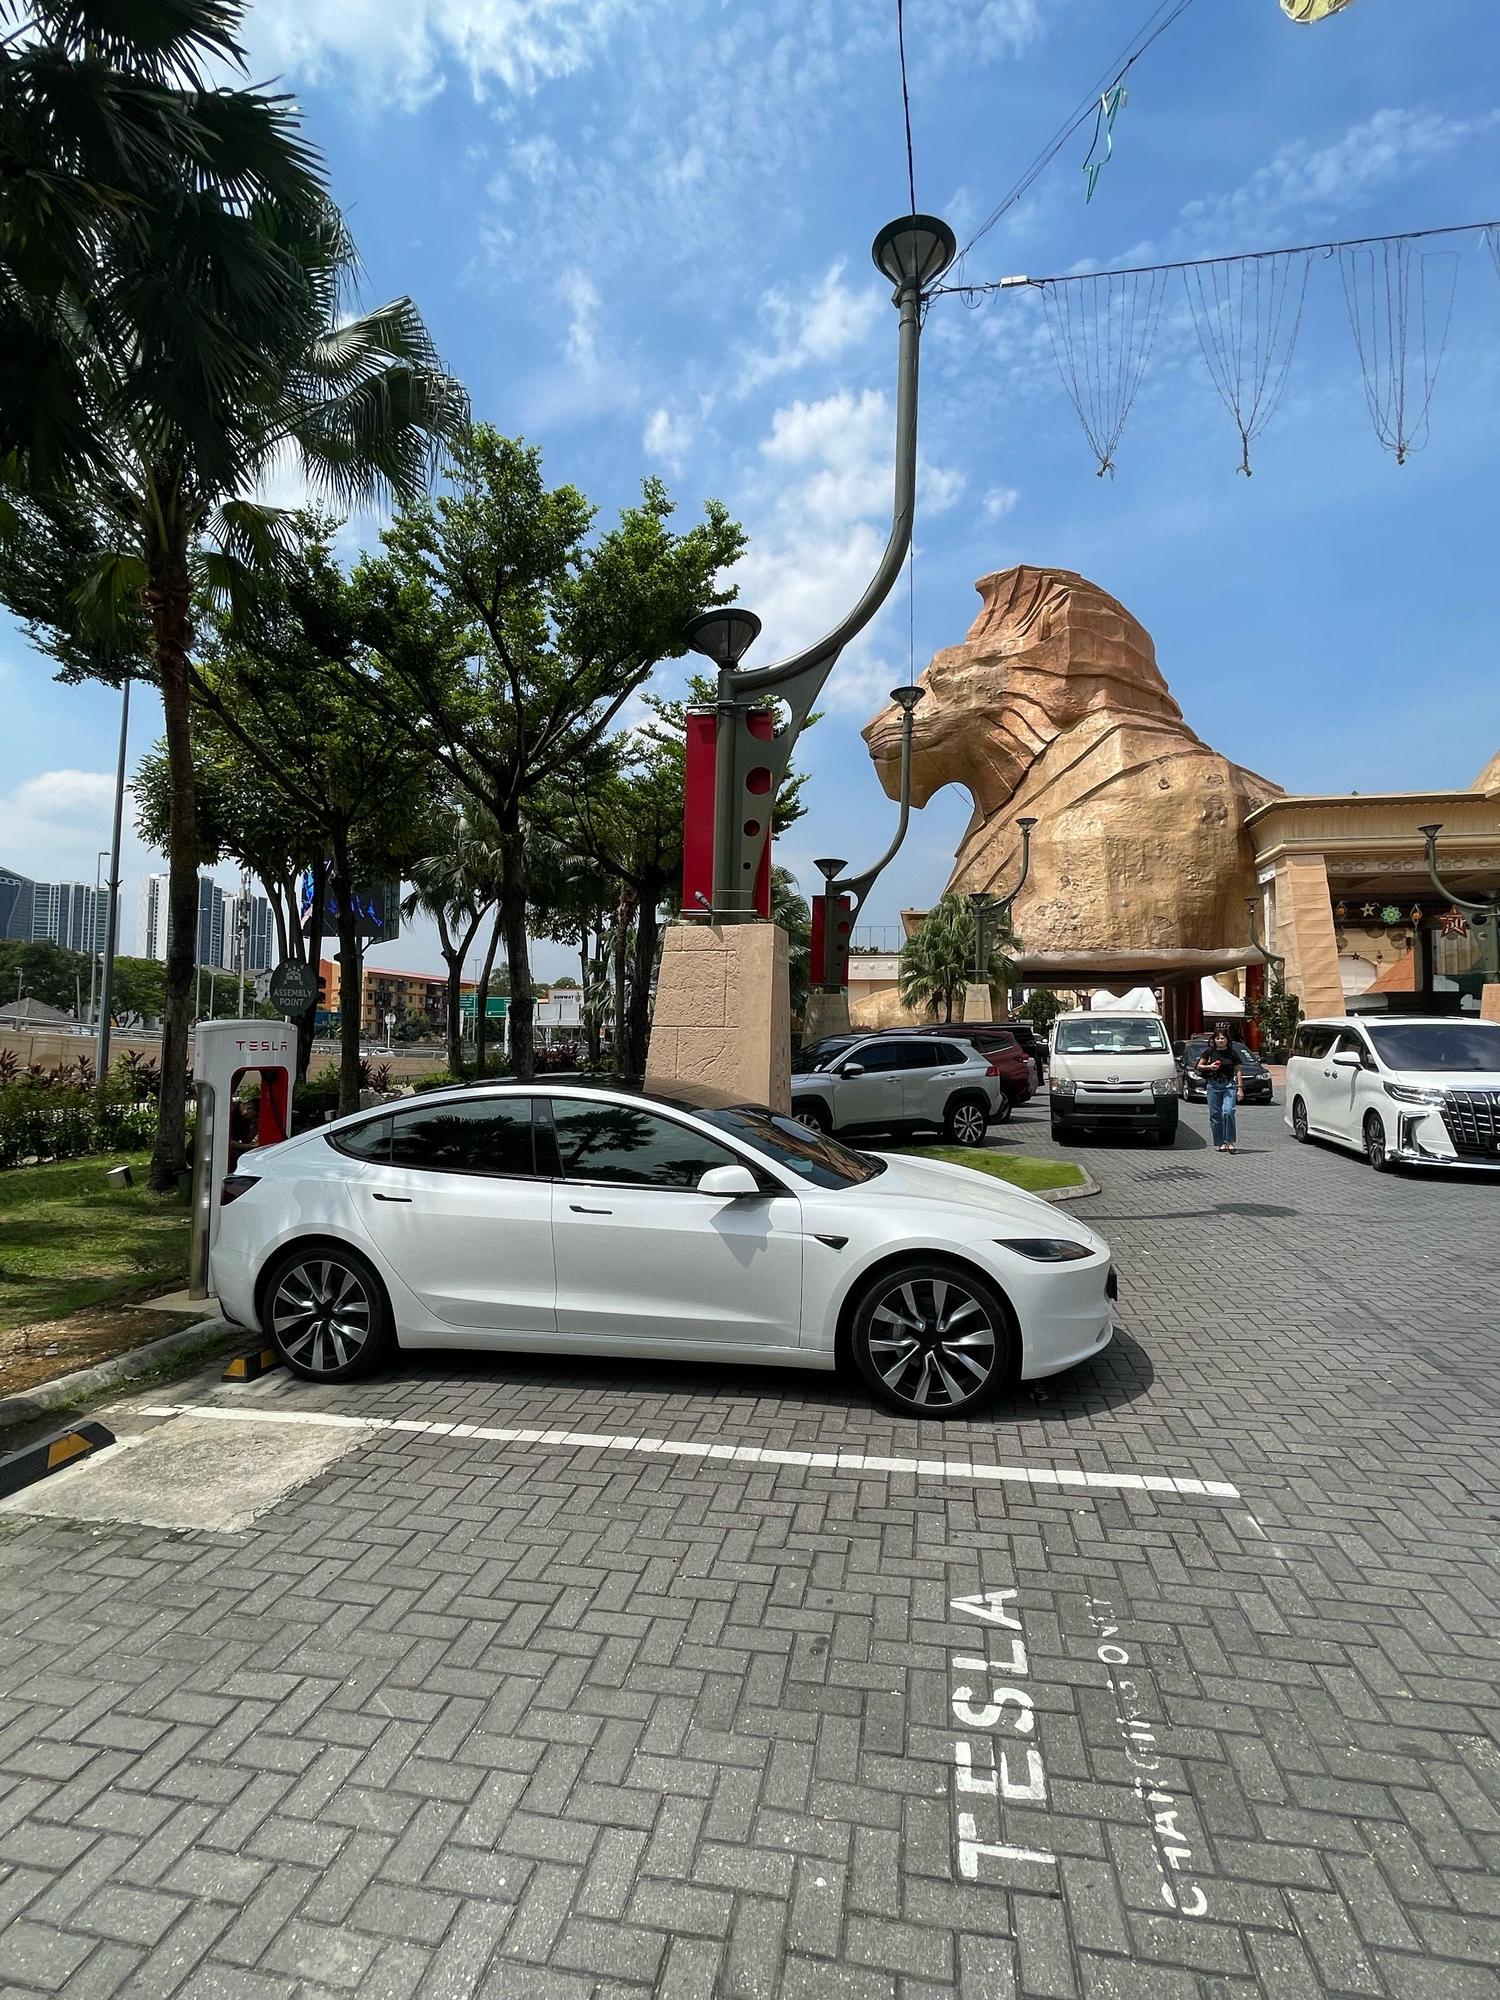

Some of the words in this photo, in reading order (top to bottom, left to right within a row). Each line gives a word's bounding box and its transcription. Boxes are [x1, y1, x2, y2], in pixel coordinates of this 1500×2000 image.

[273, 988, 313, 998] ASSEMBLY
[279, 998, 304, 1006] POINT
[235, 1040, 288, 1052] TESLA
[949, 1587, 1057, 1878] TESLA
